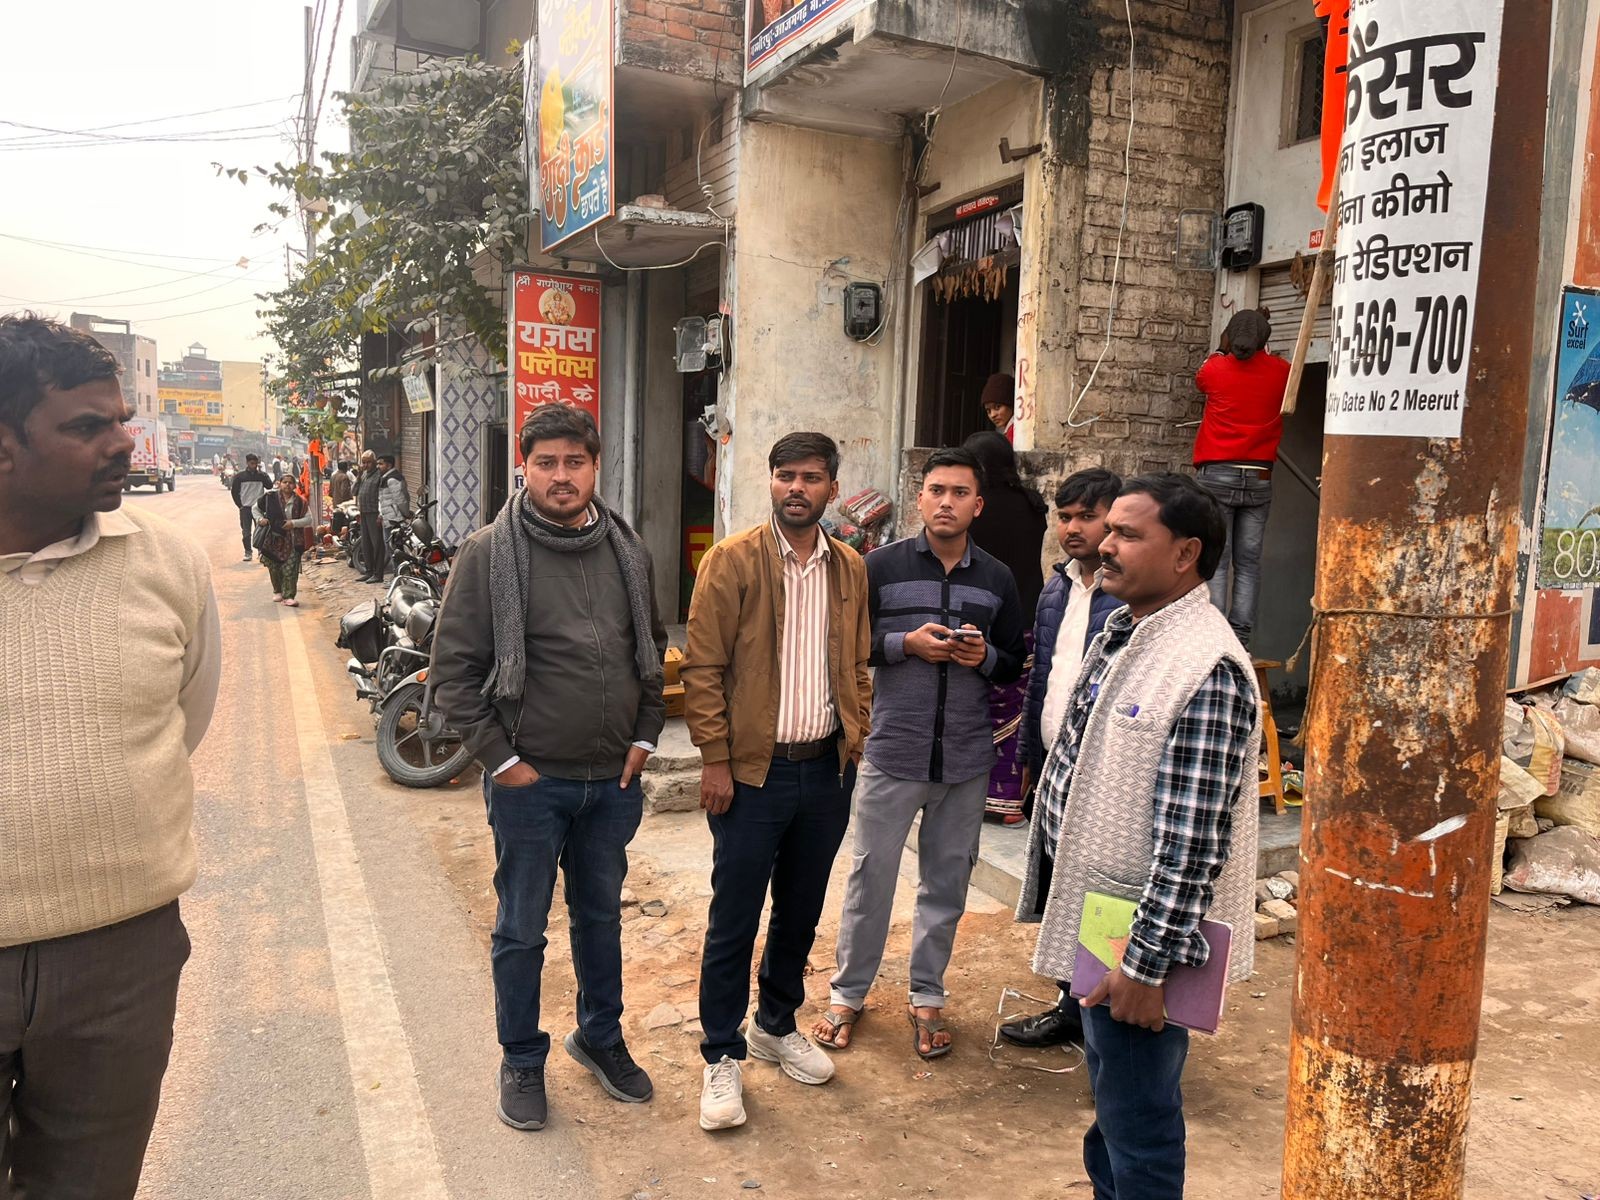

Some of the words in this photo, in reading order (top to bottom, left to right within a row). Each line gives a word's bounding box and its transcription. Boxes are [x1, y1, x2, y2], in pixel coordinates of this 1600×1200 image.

[1361, 123, 1449, 171] इलाज
[1371, 170, 1453, 219] कीमो
[1352, 234, 1473, 281] रेडिएशन
[517, 321, 596, 352] यजस
[1566, 339, 1586, 350] excel
[1568, 320, 1589, 338] Surf
[516, 381, 562, 407] शादी
[571, 384, 596, 402] के
[1342, 391, 1366, 412] Gate
[1368, 390, 1386, 412] No
[1389, 389, 1400, 411] 2
[1403, 389, 1460, 411] Meerut
[1554, 530, 1597, 578] 80
